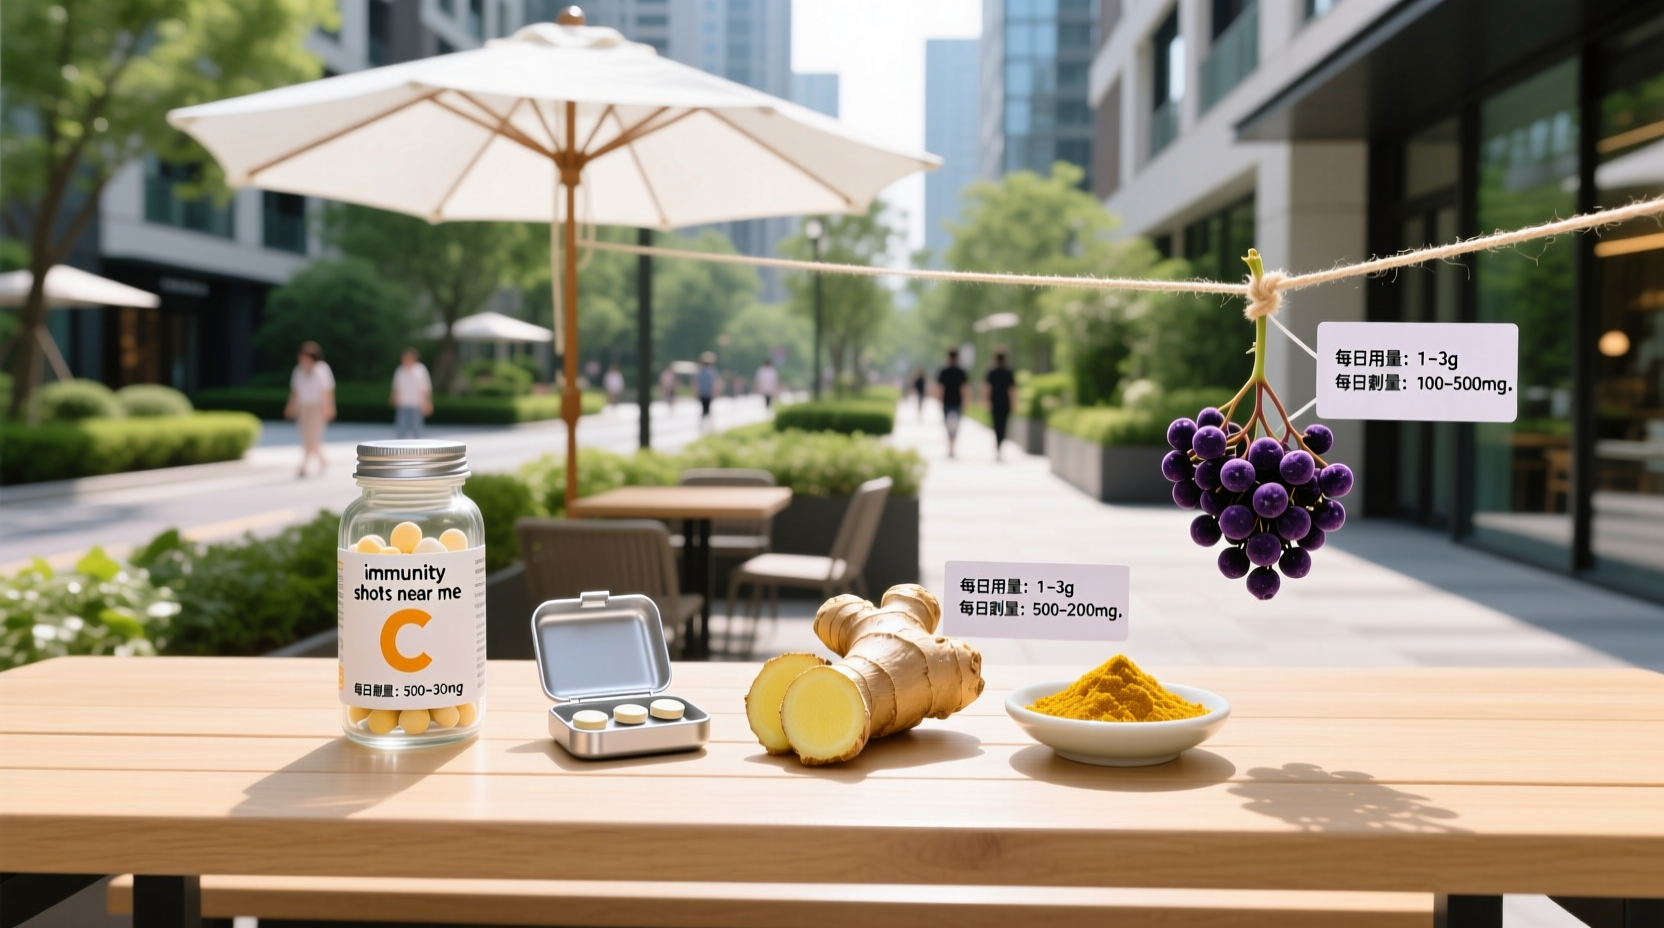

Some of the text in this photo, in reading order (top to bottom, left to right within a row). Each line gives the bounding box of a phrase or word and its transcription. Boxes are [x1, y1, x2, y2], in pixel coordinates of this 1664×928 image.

[1418, 351, 1458, 370] 1-3g
[1417, 376, 1513, 395] 100-500mg.
[364, 563, 446, 584] immunity
[354, 584, 462, 602] shots near me
[1037, 580, 1074, 598] 1-3g
[380, 607, 432, 673] C
